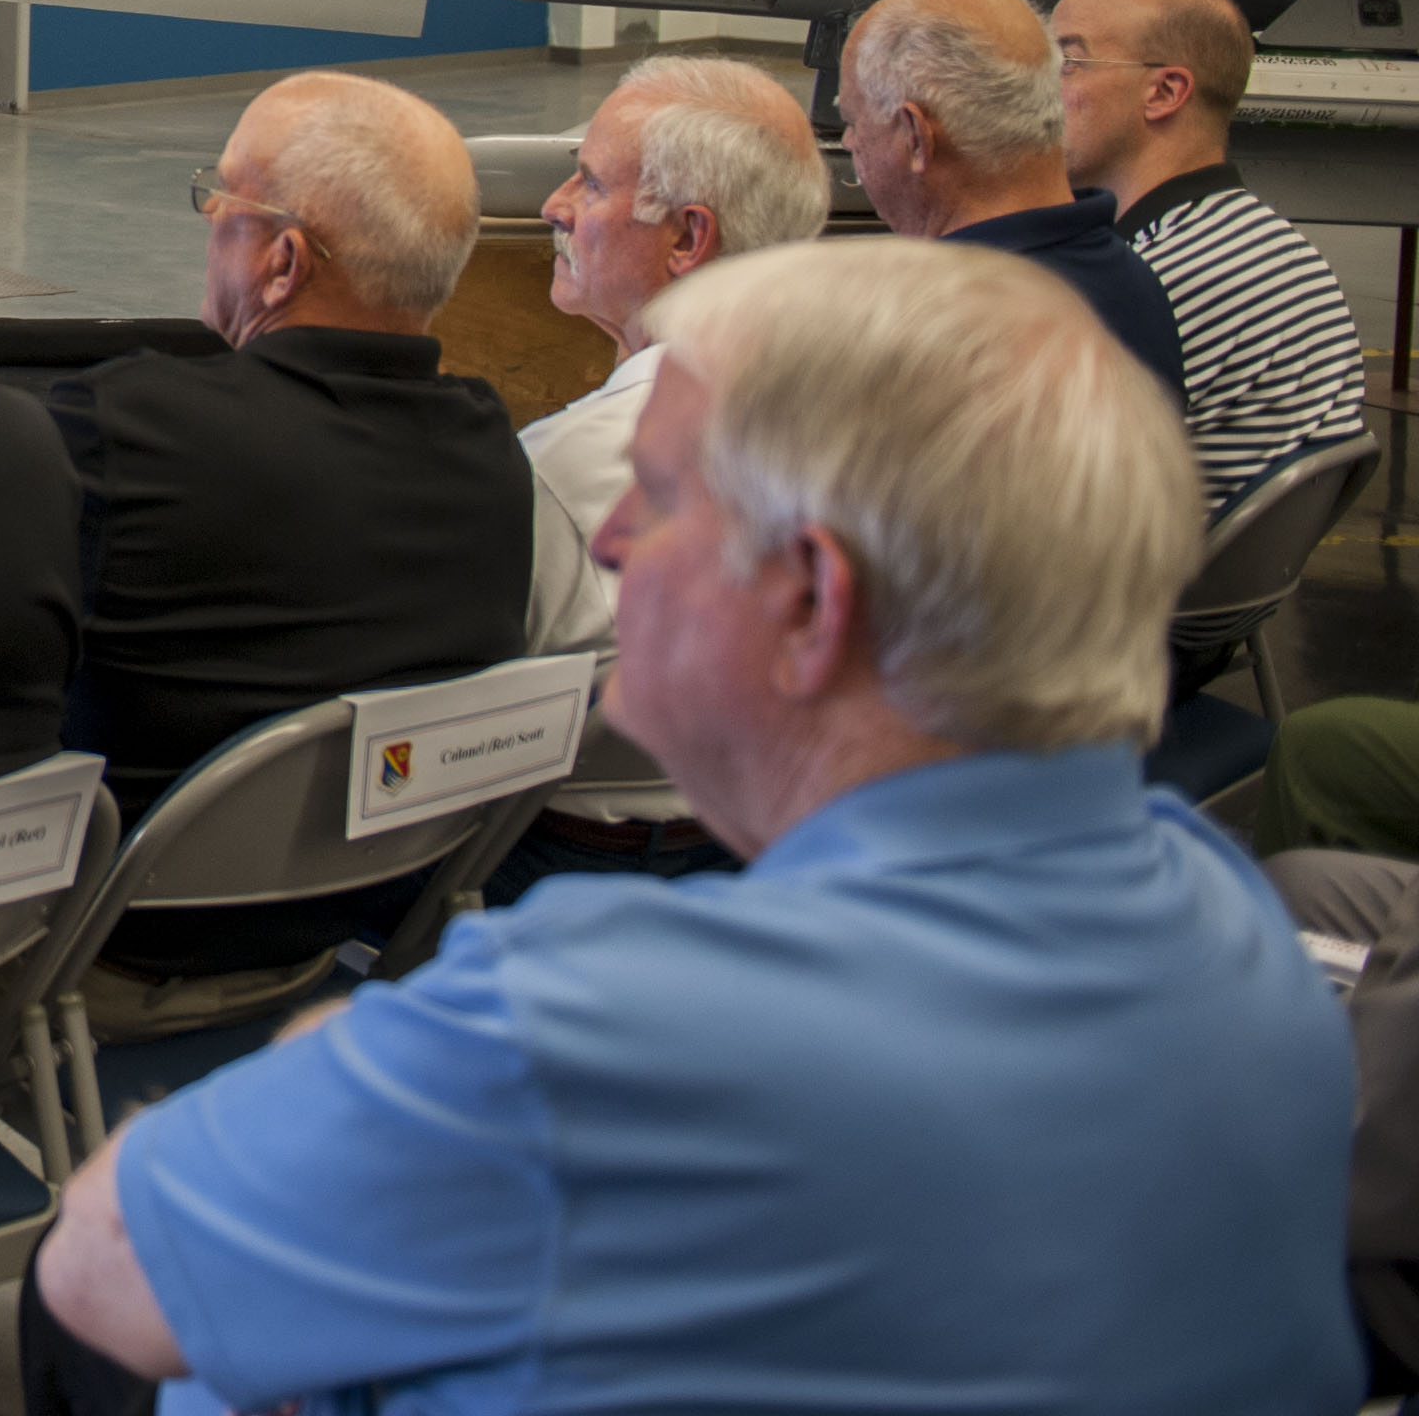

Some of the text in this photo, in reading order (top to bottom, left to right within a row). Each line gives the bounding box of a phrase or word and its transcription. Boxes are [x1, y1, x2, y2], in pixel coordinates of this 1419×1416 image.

[440, 740, 485, 764] Colonel
[487, 735, 515, 754] (Ret)
[7, 825, 47, 848] (Ret)
